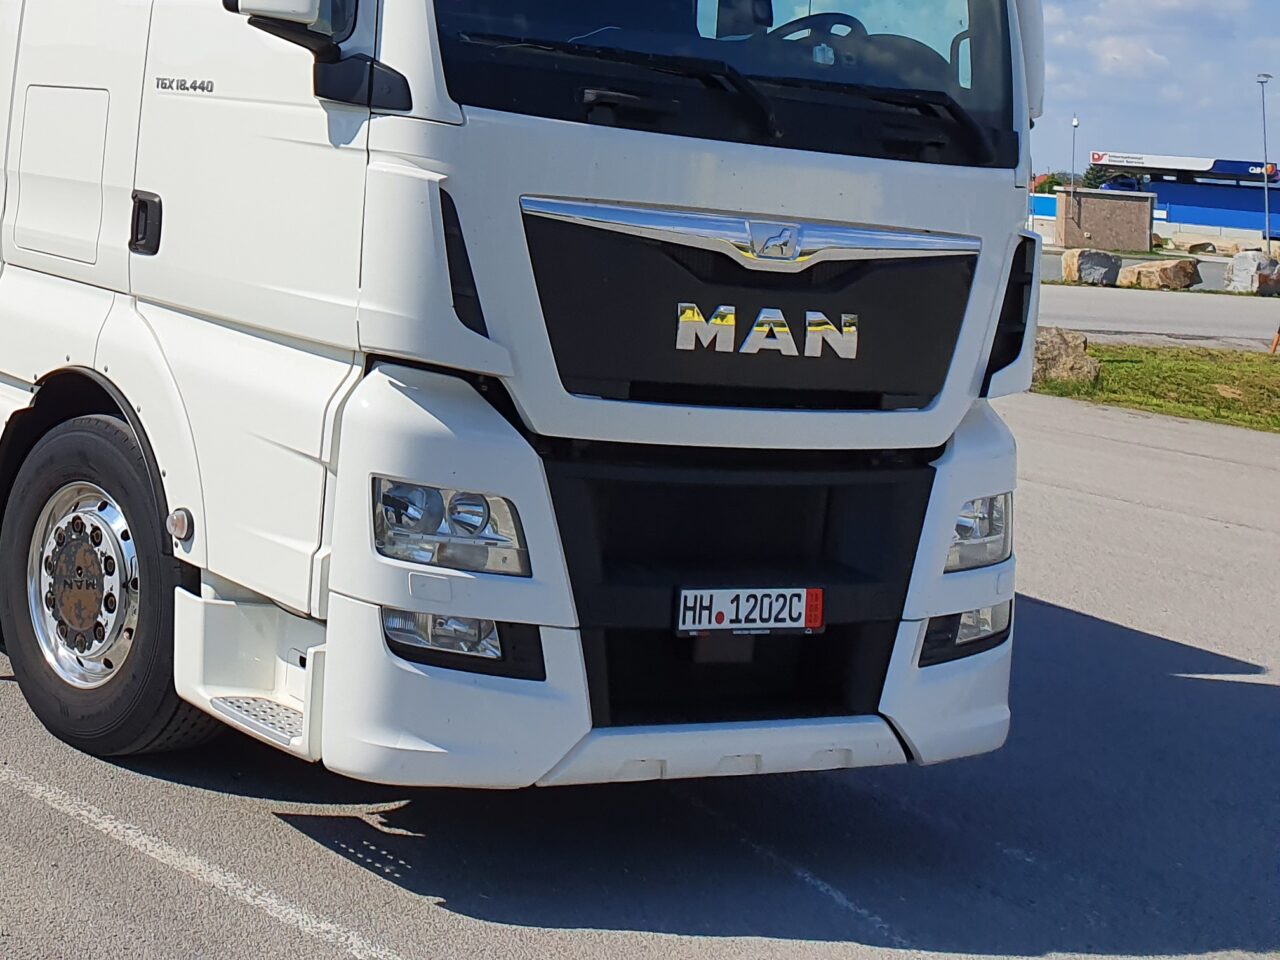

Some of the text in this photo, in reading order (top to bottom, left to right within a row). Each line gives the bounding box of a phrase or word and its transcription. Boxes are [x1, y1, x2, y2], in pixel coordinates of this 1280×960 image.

[155, 77, 215, 93] TGX 18.440
[676, 302, 859, 360] MAN
[63, 579, 97, 590] MAN
